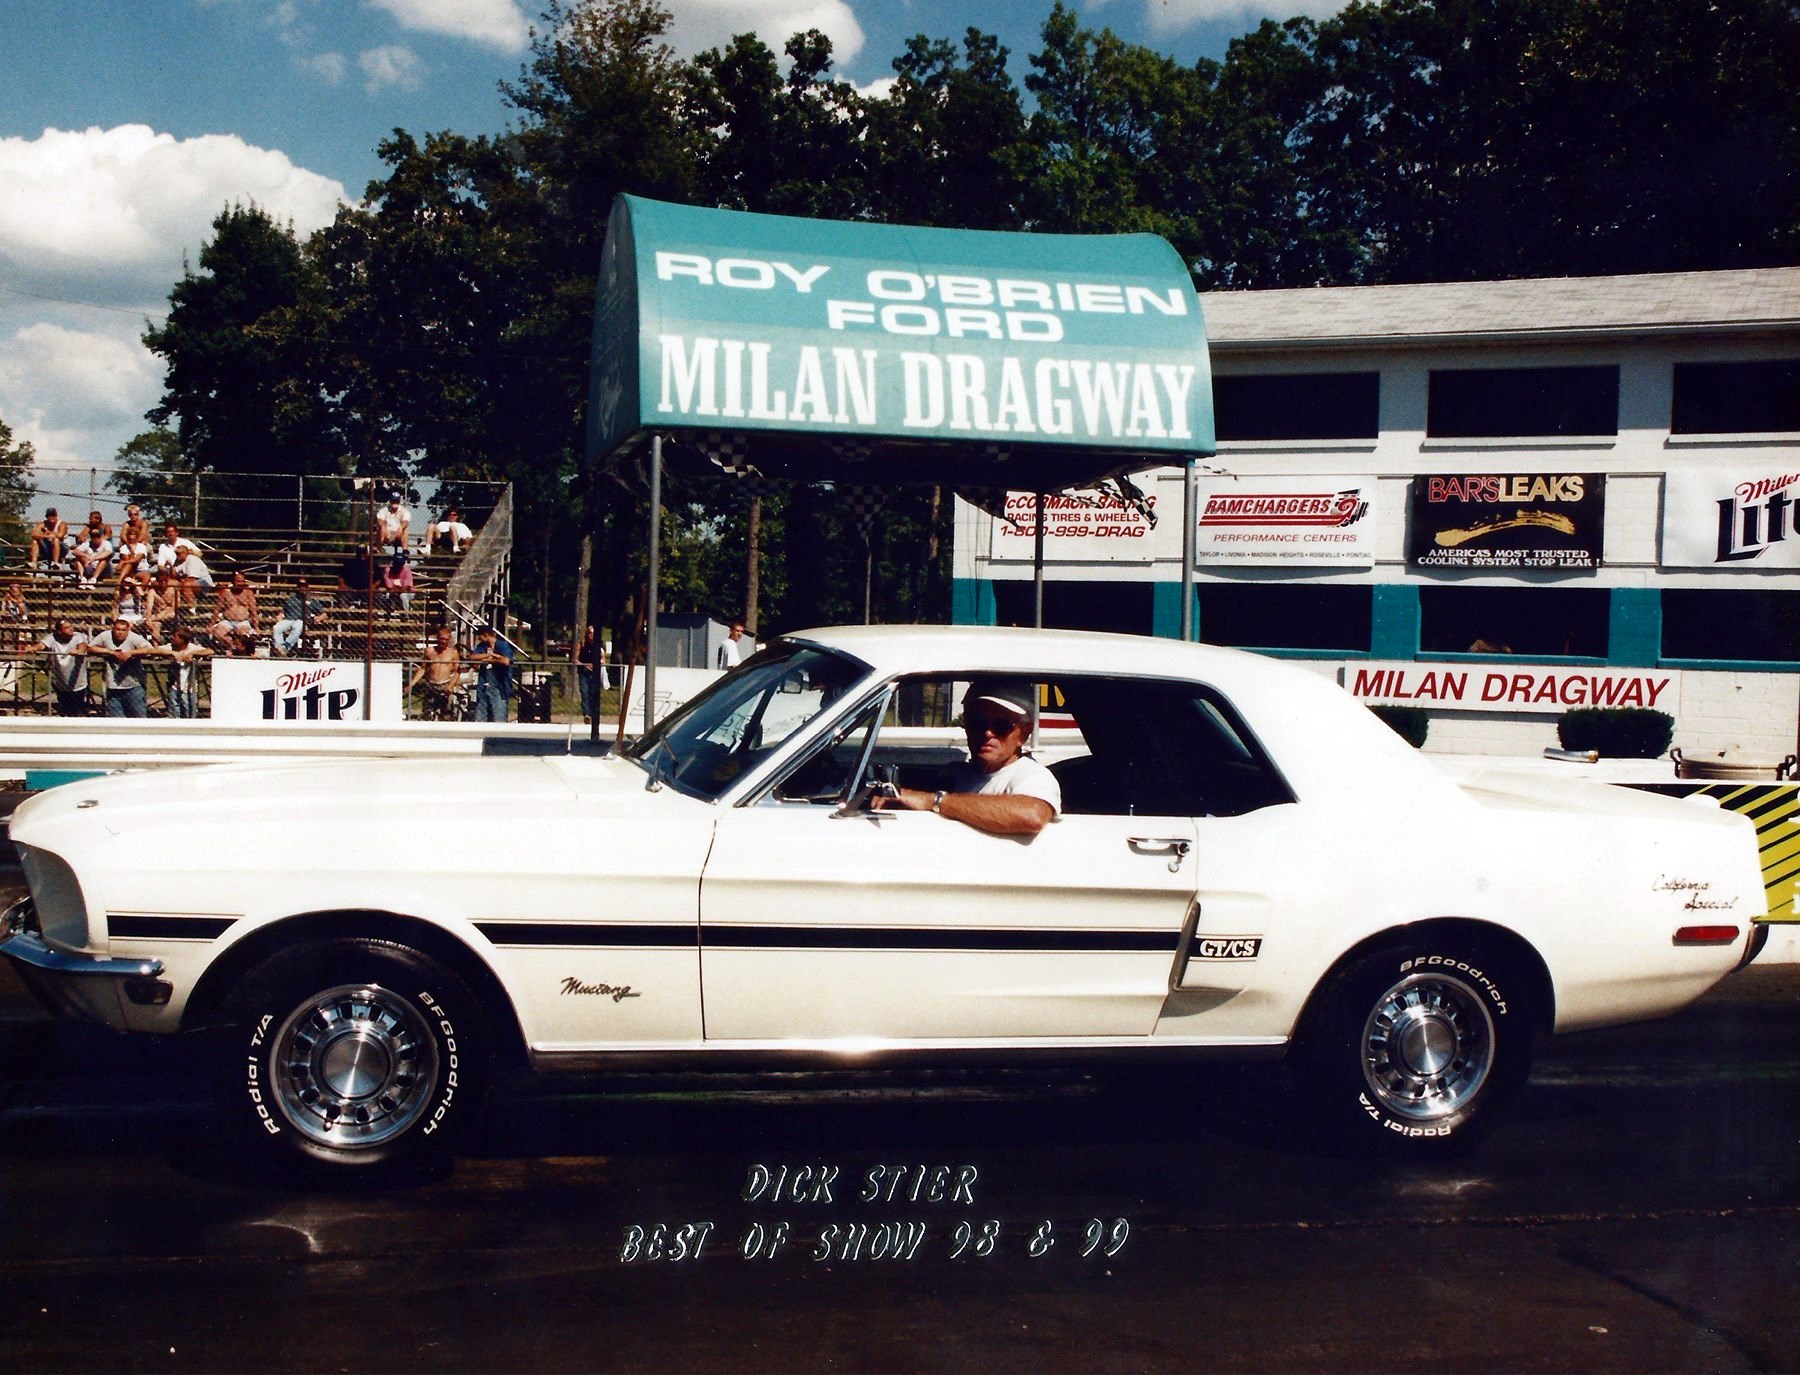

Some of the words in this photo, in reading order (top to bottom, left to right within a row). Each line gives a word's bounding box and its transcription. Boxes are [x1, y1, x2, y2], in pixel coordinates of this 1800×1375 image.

[655, 251, 831, 294] ROY
[867, 269, 1188, 316] O'BRIEN
[826, 299, 1064, 343] FORD
[657, 334, 878, 426] MILAN
[901, 350, 1196, 440] DRAGWAY
[1499, 476, 1584, 503] LEAKS
[1052, 513, 1081, 522] TIRES
[1083, 513, 1092, 522] &
[1094, 513, 1140, 522] WHEELS
[1204, 499, 1332, 515] RAMCHARGERS
[1213, 534, 1300, 543] PERFORMANCE
[1304, 534, 1357, 543] CENTERS
[1714, 490, 1800, 563] Lit
[1417, 557, 1469, 566] COOLING
[1472, 557, 1520, 566] SYSTEM
[1524, 558, 1556, 567] STOP
[1559, 558, 1592, 567] LEAK
[1495, 550, 1529, 558] MOST
[1533, 550, 1589, 559] TRUSTED
[276, 667, 336, 695] Miller
[1353, 669, 1468, 700] MILAN
[1481, 673, 1670, 706] DRAGWAY
[1200, 940, 1255, 957] GT/CS
[560, 976, 642, 1003] Mustang
[1400, 956, 1508, 1015] BFGoodrich
[251, 1013, 274, 1048] T/A
[418, 991, 459, 1135] BFGoodrich
[248, 1056, 281, 1135] Radial
[1358, 1092, 1380, 1121] T/A
[1383, 1119, 1452, 1137] Radial
